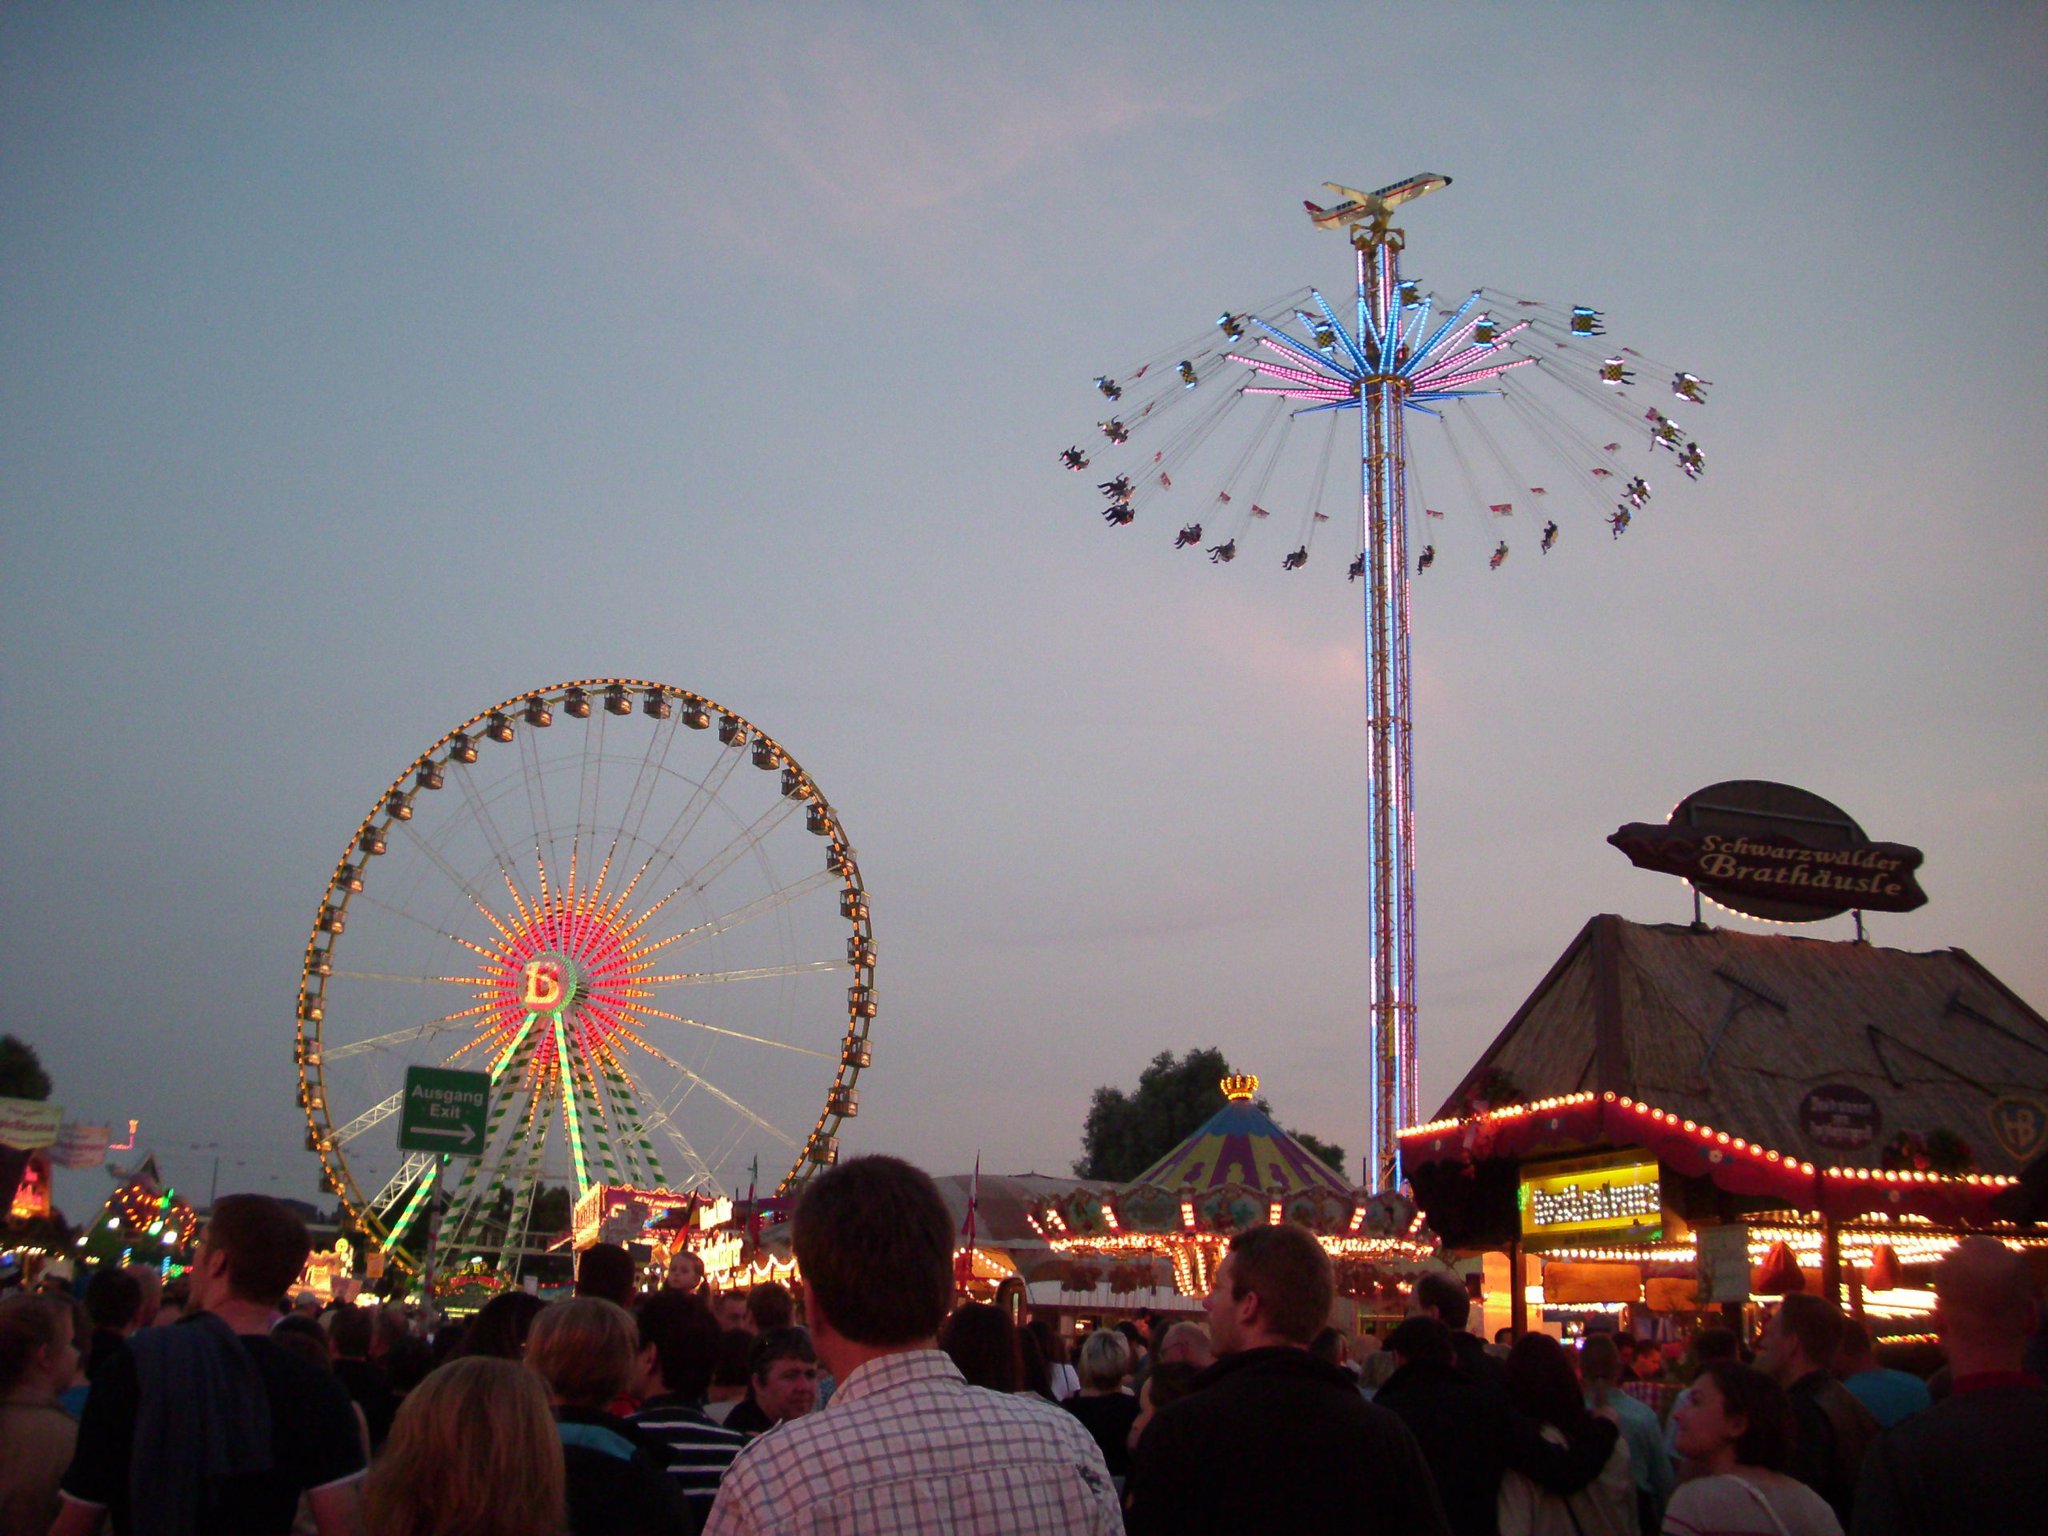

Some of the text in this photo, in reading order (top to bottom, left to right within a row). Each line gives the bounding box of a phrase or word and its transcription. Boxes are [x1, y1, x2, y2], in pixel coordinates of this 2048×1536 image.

[1701, 834, 1903, 872] Schwarzwälder
[1700, 853, 1903, 896] Brathäusle
[411, 1084, 484, 1107] Ausgang
[429, 1103, 462, 1119] Exit
